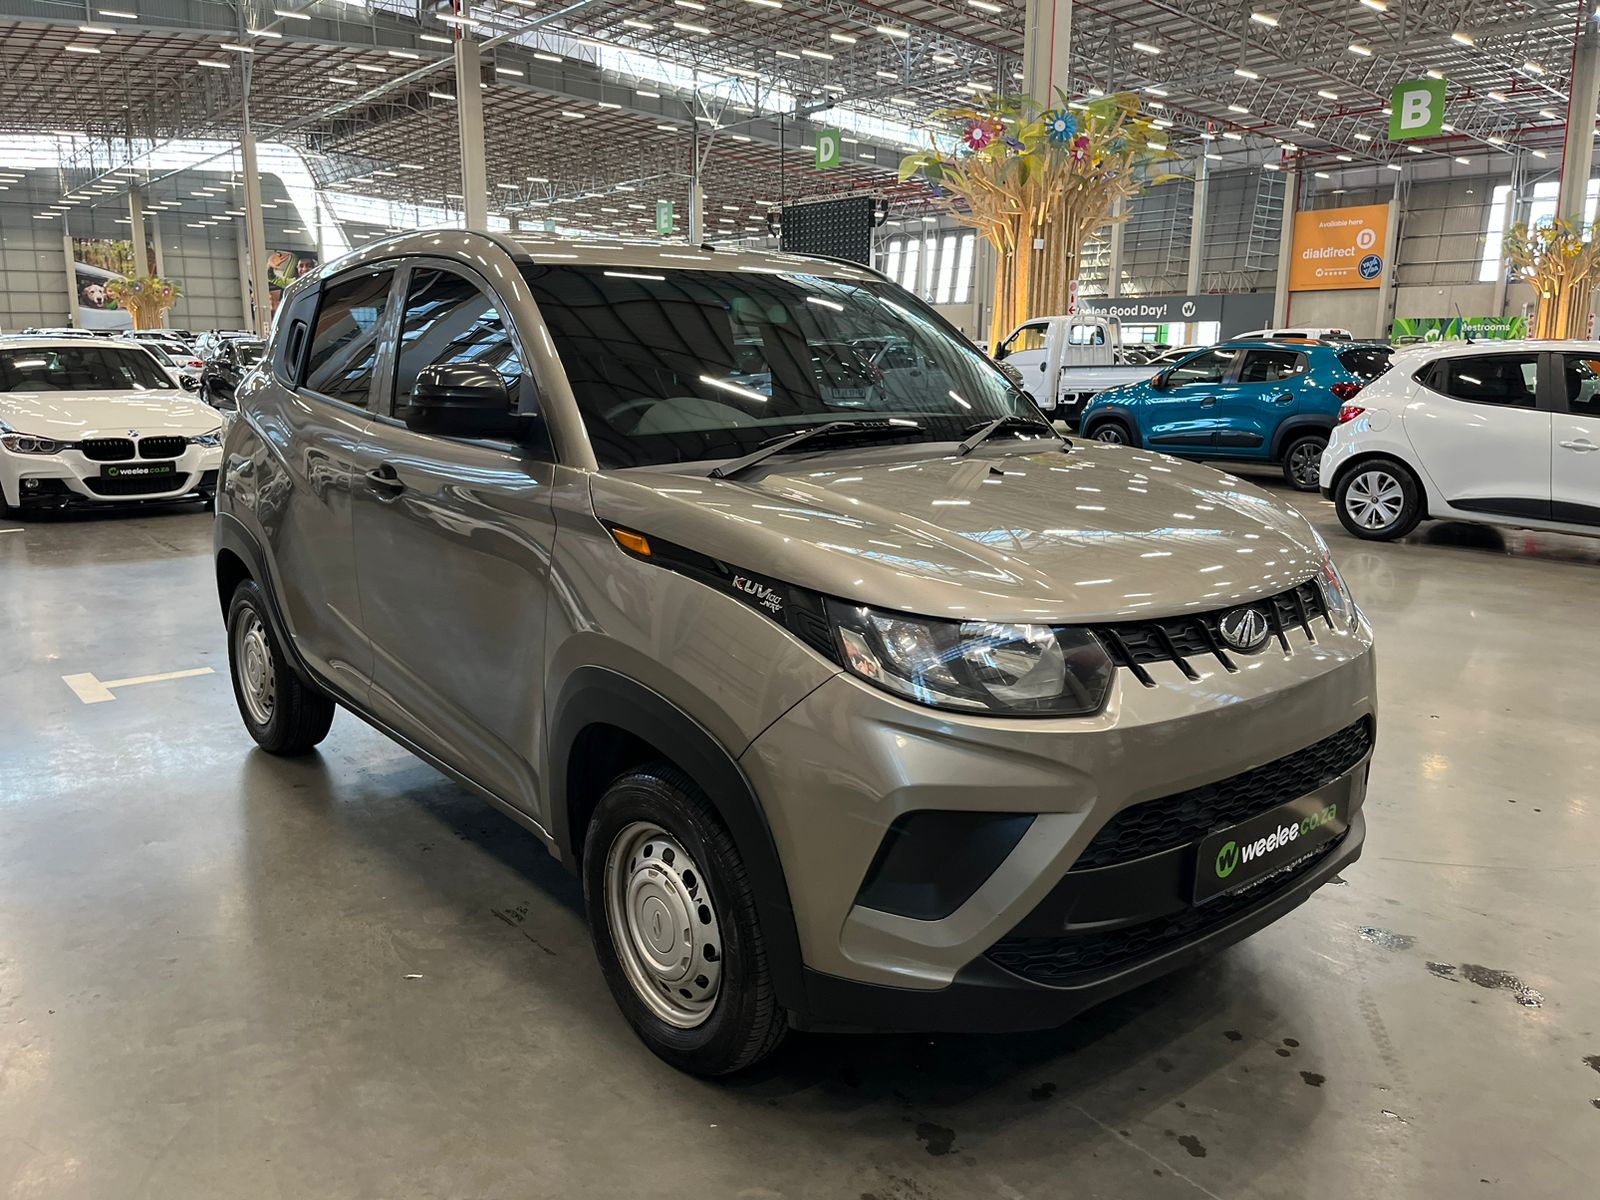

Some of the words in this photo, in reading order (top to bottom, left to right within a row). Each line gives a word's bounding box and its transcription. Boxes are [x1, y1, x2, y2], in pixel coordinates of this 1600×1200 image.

[1400, 89, 1432, 130] B
[820, 136, 835, 163] D
[660, 207, 669, 229] E
[1319, 219, 1348, 228] Available
[1302, 246, 1356, 260] dialdirect
[1077, 306, 1108, 316] eelee
[1109, 305, 1138, 316] Good
[1140, 304, 1168, 319] Day!
[1241, 803, 1337, 863] weelee.co.za
